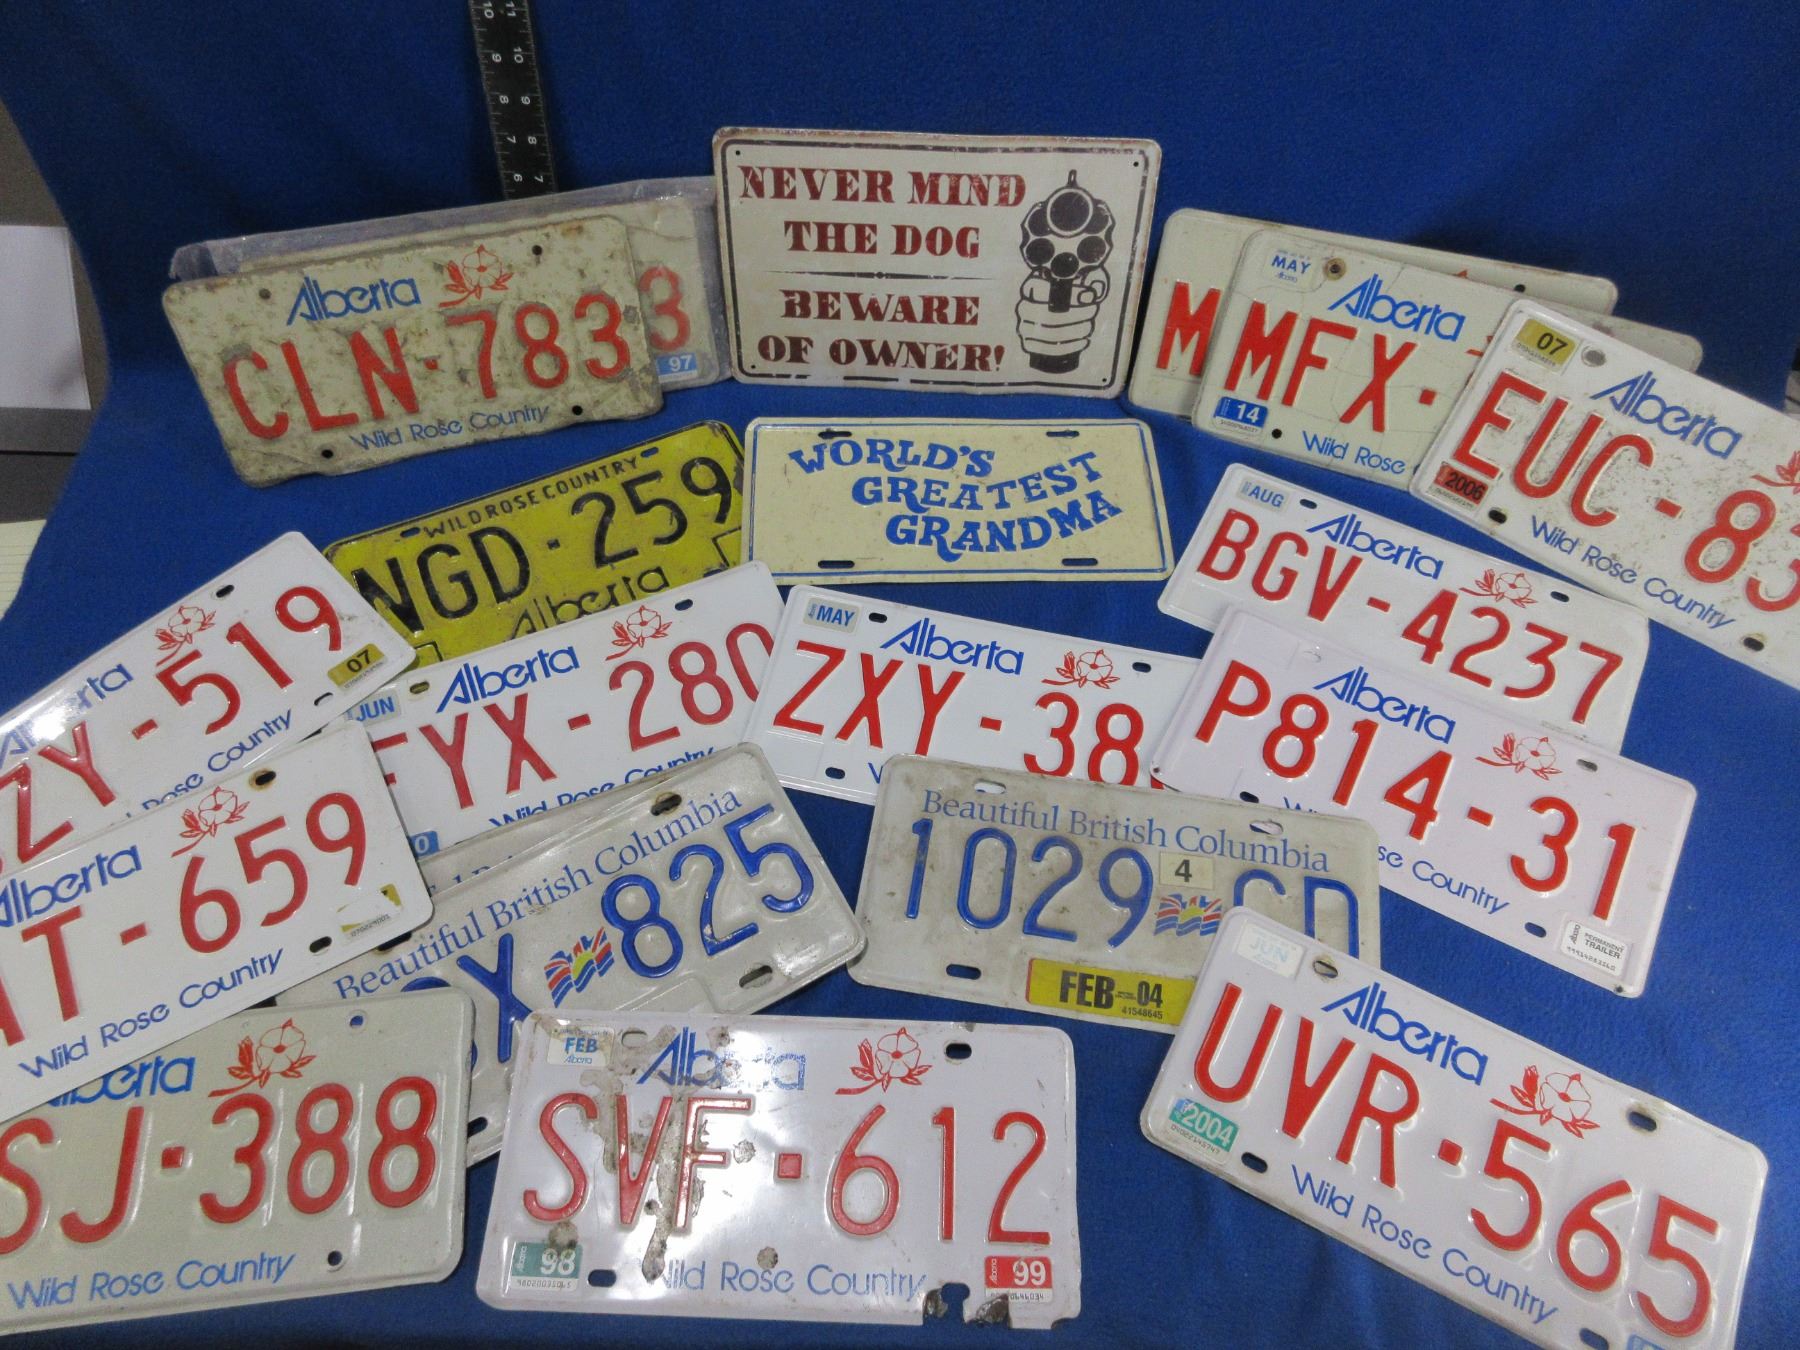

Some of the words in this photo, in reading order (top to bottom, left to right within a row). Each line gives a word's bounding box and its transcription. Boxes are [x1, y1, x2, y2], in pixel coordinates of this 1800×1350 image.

[737, 165, 895, 203] NEVER
[907, 170, 1026, 207] MIND
[784, 220, 878, 255] THE
[890, 224, 981, 259] DOG
[1271, 255, 1311, 274] MAY
[285, 275, 423, 327] Alberta
[779, 289, 980, 326] BEWARE
[1327, 274, 1465, 344] Alberta
[669, 354, 692, 372] 97
[757, 335, 814, 364] OF
[829, 338, 1005, 372] OWNER!
[1537, 332, 1568, 355] 07
[351, 427, 402, 451] Wild
[412, 418, 463, 441] Rose
[470, 403, 550, 430] Country
[1237, 403, 1260, 423] 14
[1589, 368, 1743, 460] Alberta
[789, 437, 996, 478] WORLD'S
[1302, 430, 1349, 460] Wild
[1354, 446, 1406, 475] Rose
[424, 506, 483, 539] WILD
[486, 491, 540, 520] ROSE
[542, 456, 639, 499] COUNTRY
[850, 451, 1104, 514] GREATEST
[1248, 486, 1284, 507] AUG
[1445, 472, 1485, 500] 2006
[885, 489, 1123, 563] GRANDMA
[1306, 512, 1445, 580] Alberta
[1530, 514, 1577, 554] Wild
[1578, 538, 1639, 586] Rose
[1643, 576, 1735, 630] Country
[816, 605, 855, 627] MAY
[347, 649, 370, 673] 07
[879, 617, 1024, 677] Alberta
[436, 645, 581, 714] Alberta
[0, 585, 342, 864] ZY-519
[356, 696, 395, 721] JUN
[773, 640, 1164, 789] ZXY-38
[1313, 665, 1457, 745] Alberta
[207, 708, 292, 772] Country
[922, 789, 1060, 833] Beautiful
[1070, 809, 1169, 849] British
[1176, 825, 1329, 873] Columbia
[334, 919, 491, 999] Beautiful
[487, 863, 594, 931] British
[594, 787, 743, 879] Columbia
[601, 803, 815, 978] 825
[905, 818, 1155, 949] 1029
[1173, 859, 1193, 883] 4
[1412, 860, 1510, 915] Country
[1585, 939, 1621, 959] TRAILER
[18, 1035, 89, 1078] Wild
[100, 1003, 170, 1048] Rose
[179, 948, 284, 1009] Country
[1059, 970, 1116, 1009] FEB
[1137, 980, 1163, 1008] 04
[565, 1037, 598, 1053] FEB
[1321, 981, 1489, 1087] Alberta
[1181, 1103, 1234, 1147] 2004
[540, 1248, 576, 1275] 98
[1291, 1164, 1353, 1219] Wild
[1361, 1203, 1432, 1260] Rose
[1442, 1247, 1559, 1325] Country
[8, 1276, 78, 1309] Wild
[89, 1269, 164, 1300] Rose
[176, 1252, 296, 1290] Country
[721, 1261, 795, 1293] Rose
[807, 1263, 927, 1302] Country
[1013, 1260, 1046, 1286] 99
